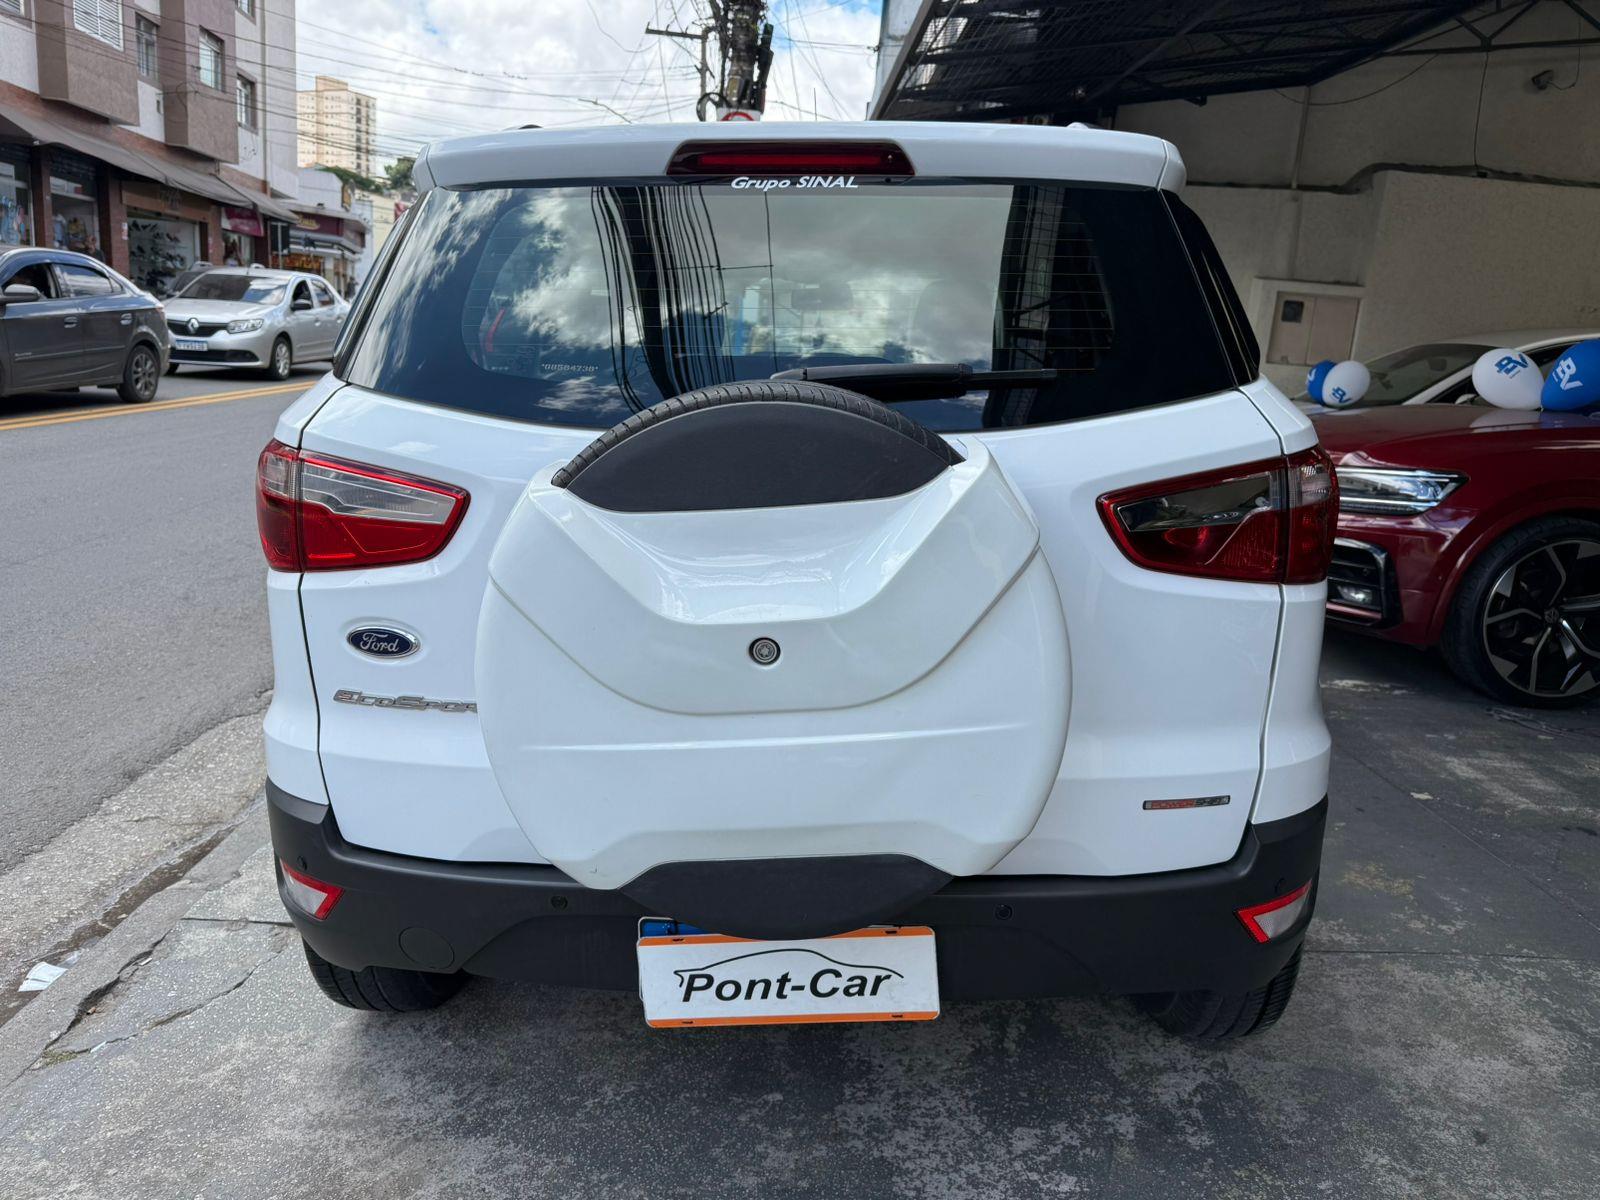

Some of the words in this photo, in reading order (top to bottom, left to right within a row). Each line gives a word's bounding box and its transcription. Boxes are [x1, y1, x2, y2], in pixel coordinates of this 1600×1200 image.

[731, 176, 790, 191] Grupo
[796, 176, 859, 188] SINAL
[360, 633, 399, 652] Ford
[333, 690, 477, 713] EcoSpor
[682, 969, 892, 1002] Pont-Car
